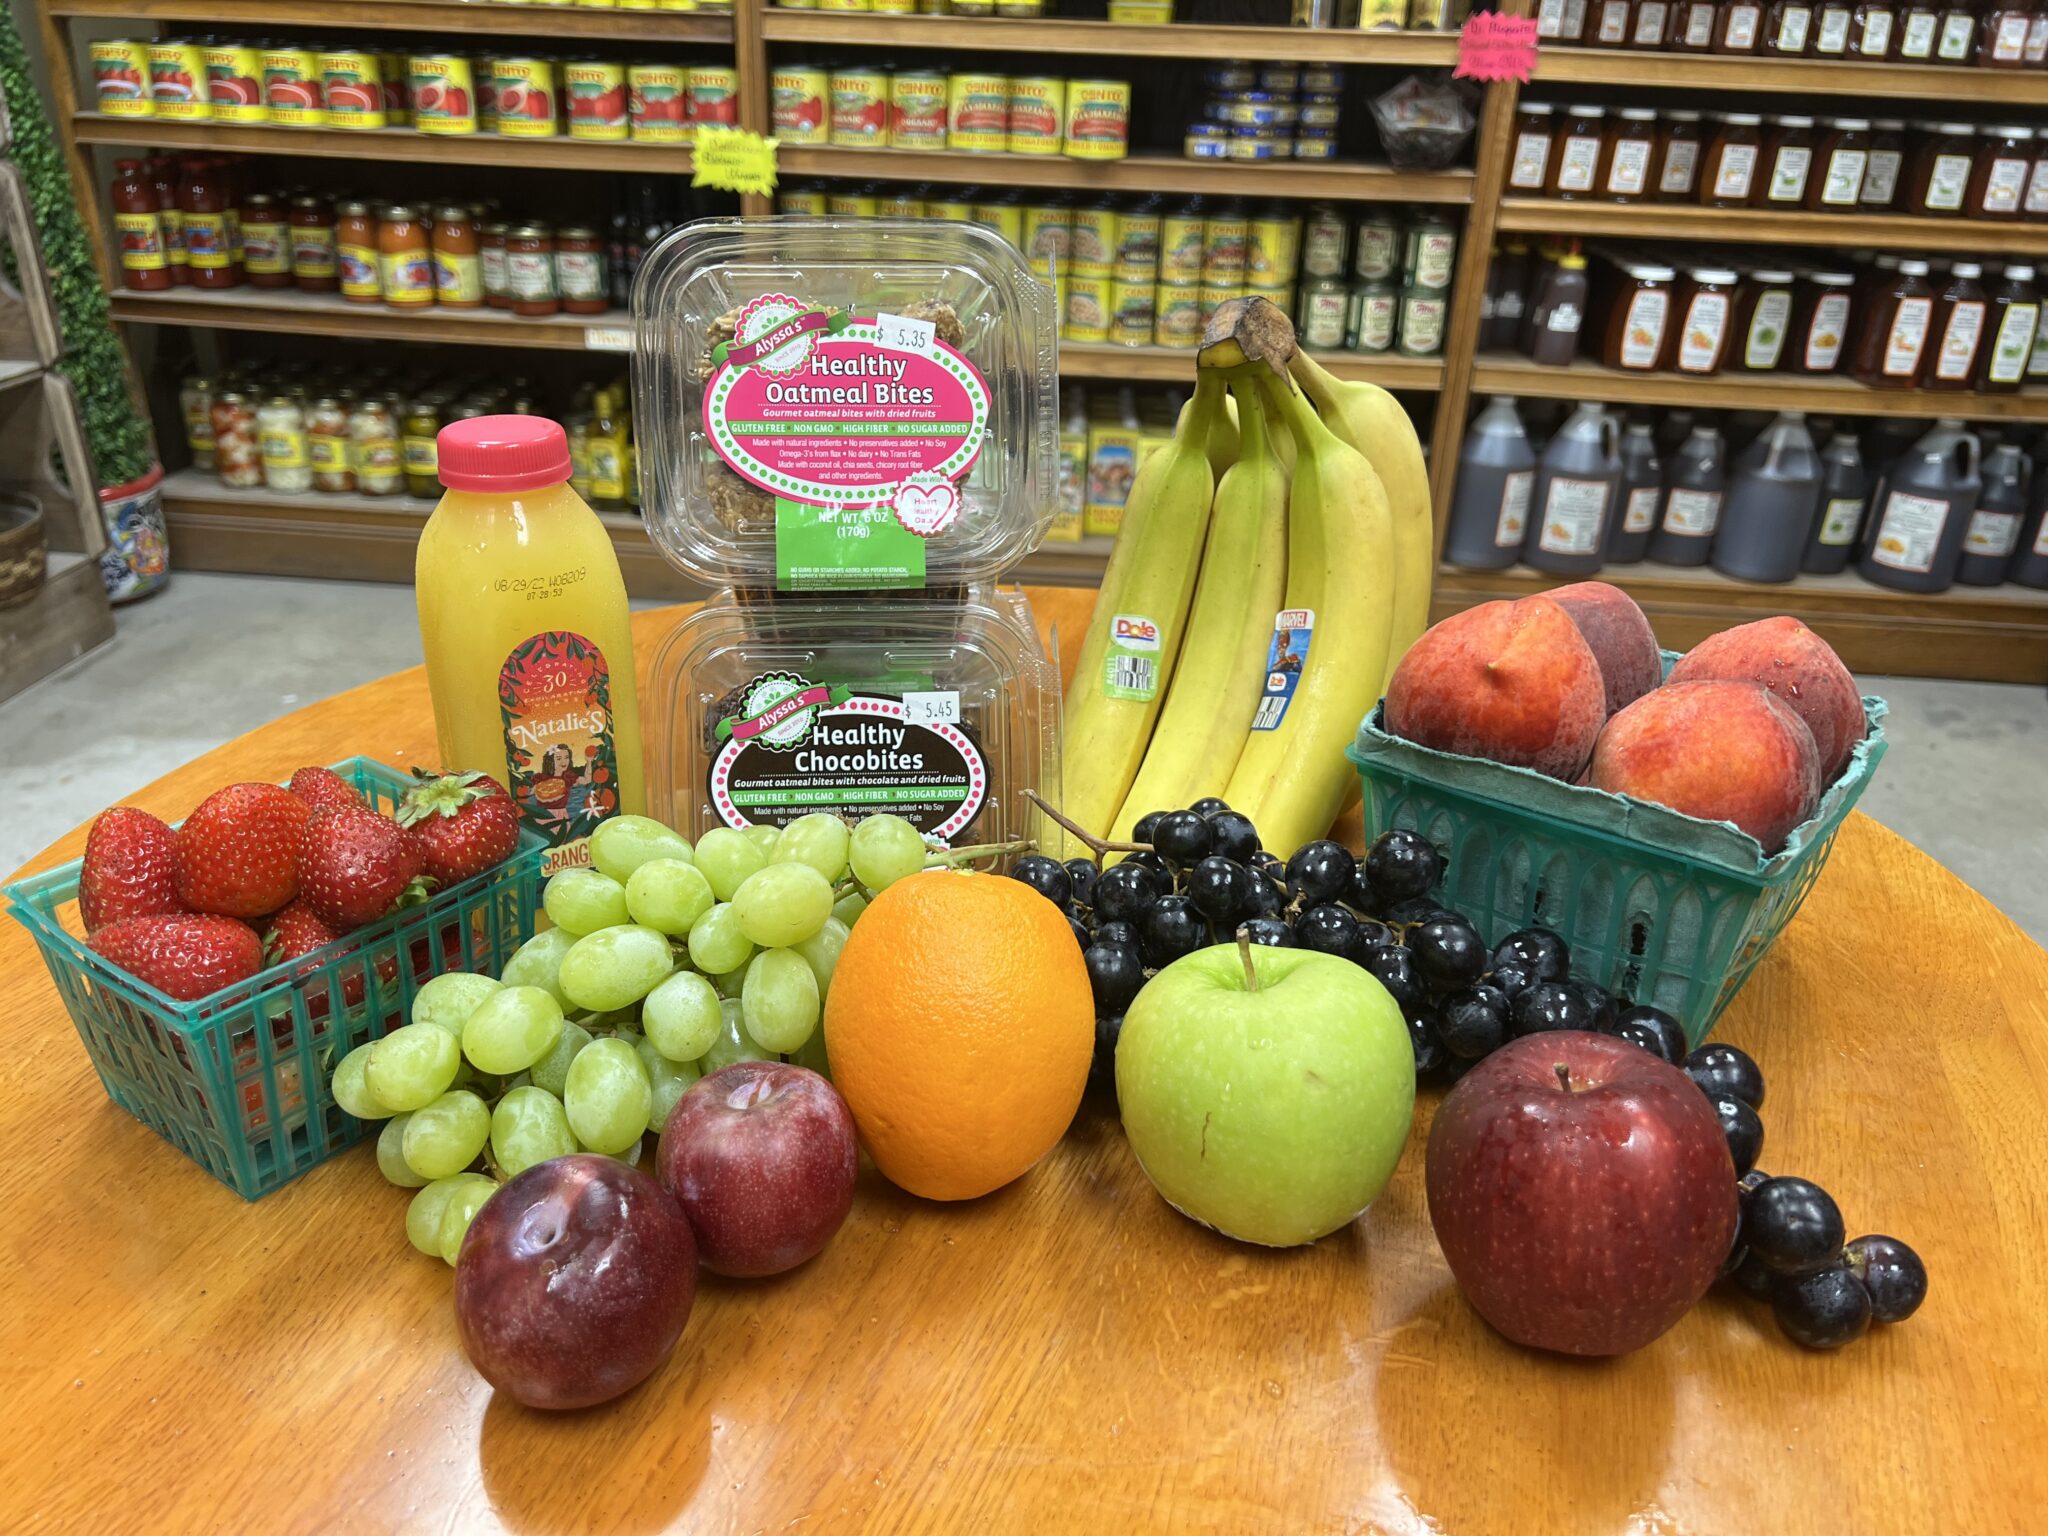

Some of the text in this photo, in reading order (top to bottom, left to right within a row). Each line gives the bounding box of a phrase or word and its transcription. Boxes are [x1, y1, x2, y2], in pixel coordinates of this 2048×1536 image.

[756, 320, 802, 356] Alyssa's
[877, 327, 926, 348] $ 5.35
[811, 354, 906, 381] Healthy
[766, 382, 933, 404] Oatmeal Bites
[763, 409, 936, 417] Gourmet oatmeal bites with dried fruits
[732, 424, 968, 433] GLUTEN FREE NON GMO HIGH FIBER NO SUGAR ADDED
[753, 439, 947, 448] Made with natural ingredients No preservatives added No Soy
[819, 512, 888, 523] NET WT. 6 OZ
[837, 526, 870, 538] (170g)
[1117, 619, 1155, 637] Dole
[1282, 611, 1307, 628] MARVEL
[543, 671, 567, 693] 30
[759, 695, 805, 729] Alyssa's
[905, 701, 952, 719] $ 5.45
[813, 723, 905, 749] Healthy
[795, 749, 923, 772] Chocobites
[735, 780, 772, 788] Gourmet
[775, 778, 810, 786] oatmeal
[812, 777, 834, 785] bites
[836, 777, 855, 785] with
[857, 776, 899, 784] chocolate
[918, 775, 941, 783] dried
[942, 775, 966, 783] fruits
[734, 789, 965, 802] GLUTEN FREE NON GMO HIGH FIBER NO SUGAR ADDED
[754, 807, 771, 815] Made
[787, 806, 807, 814] natural
[858, 805, 897, 813] preservatives
[933, 803, 944, 811] Soy
[778, 817, 787, 825] No
[544, 843, 592, 870] RANG
